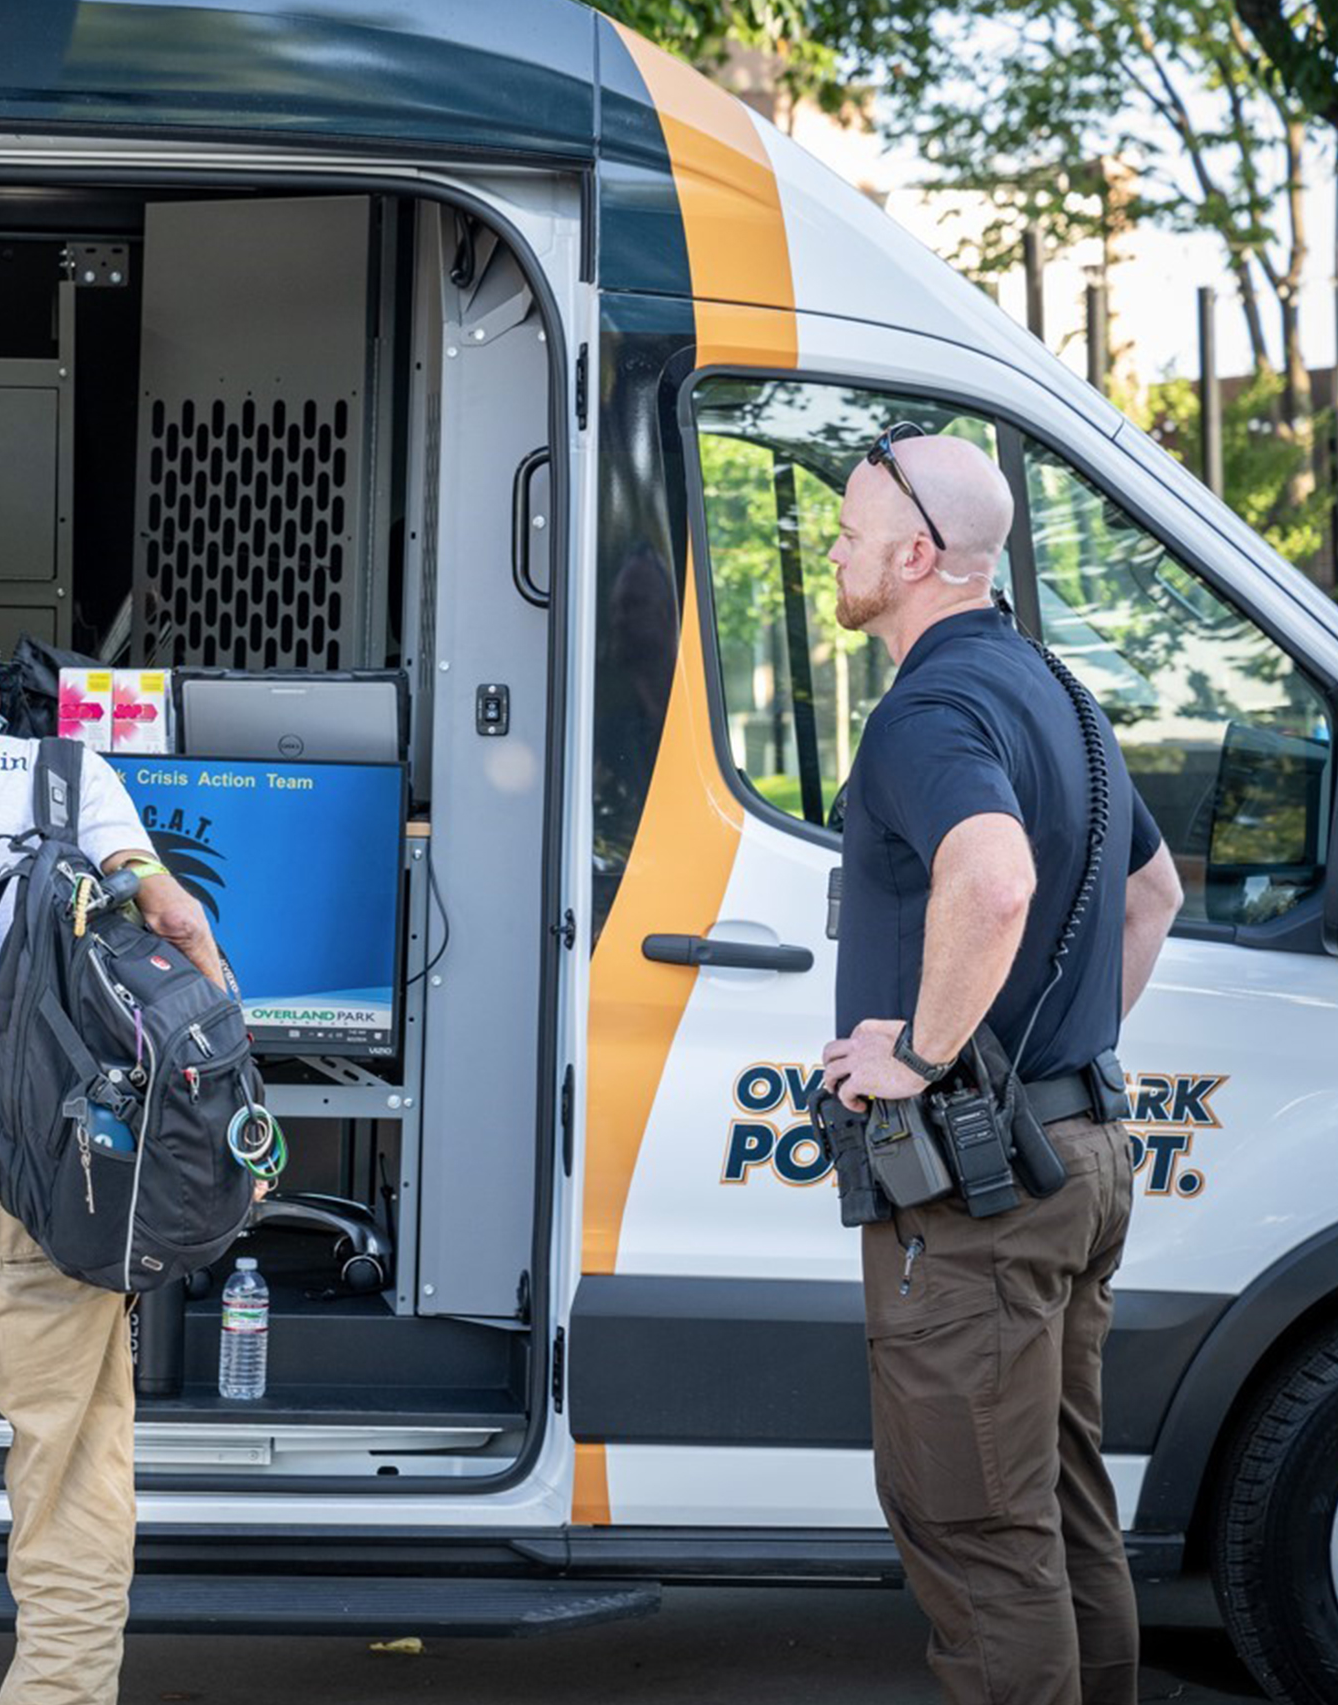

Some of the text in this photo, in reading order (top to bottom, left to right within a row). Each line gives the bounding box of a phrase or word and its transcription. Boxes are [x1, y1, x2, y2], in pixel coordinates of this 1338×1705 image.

[136, 768, 189, 787] Crisis
[197, 771, 256, 789] Action
[266, 773, 314, 790] Team
[251, 1008, 336, 1021] OVERLAND
[337, 1012, 376, 1023] PARK
